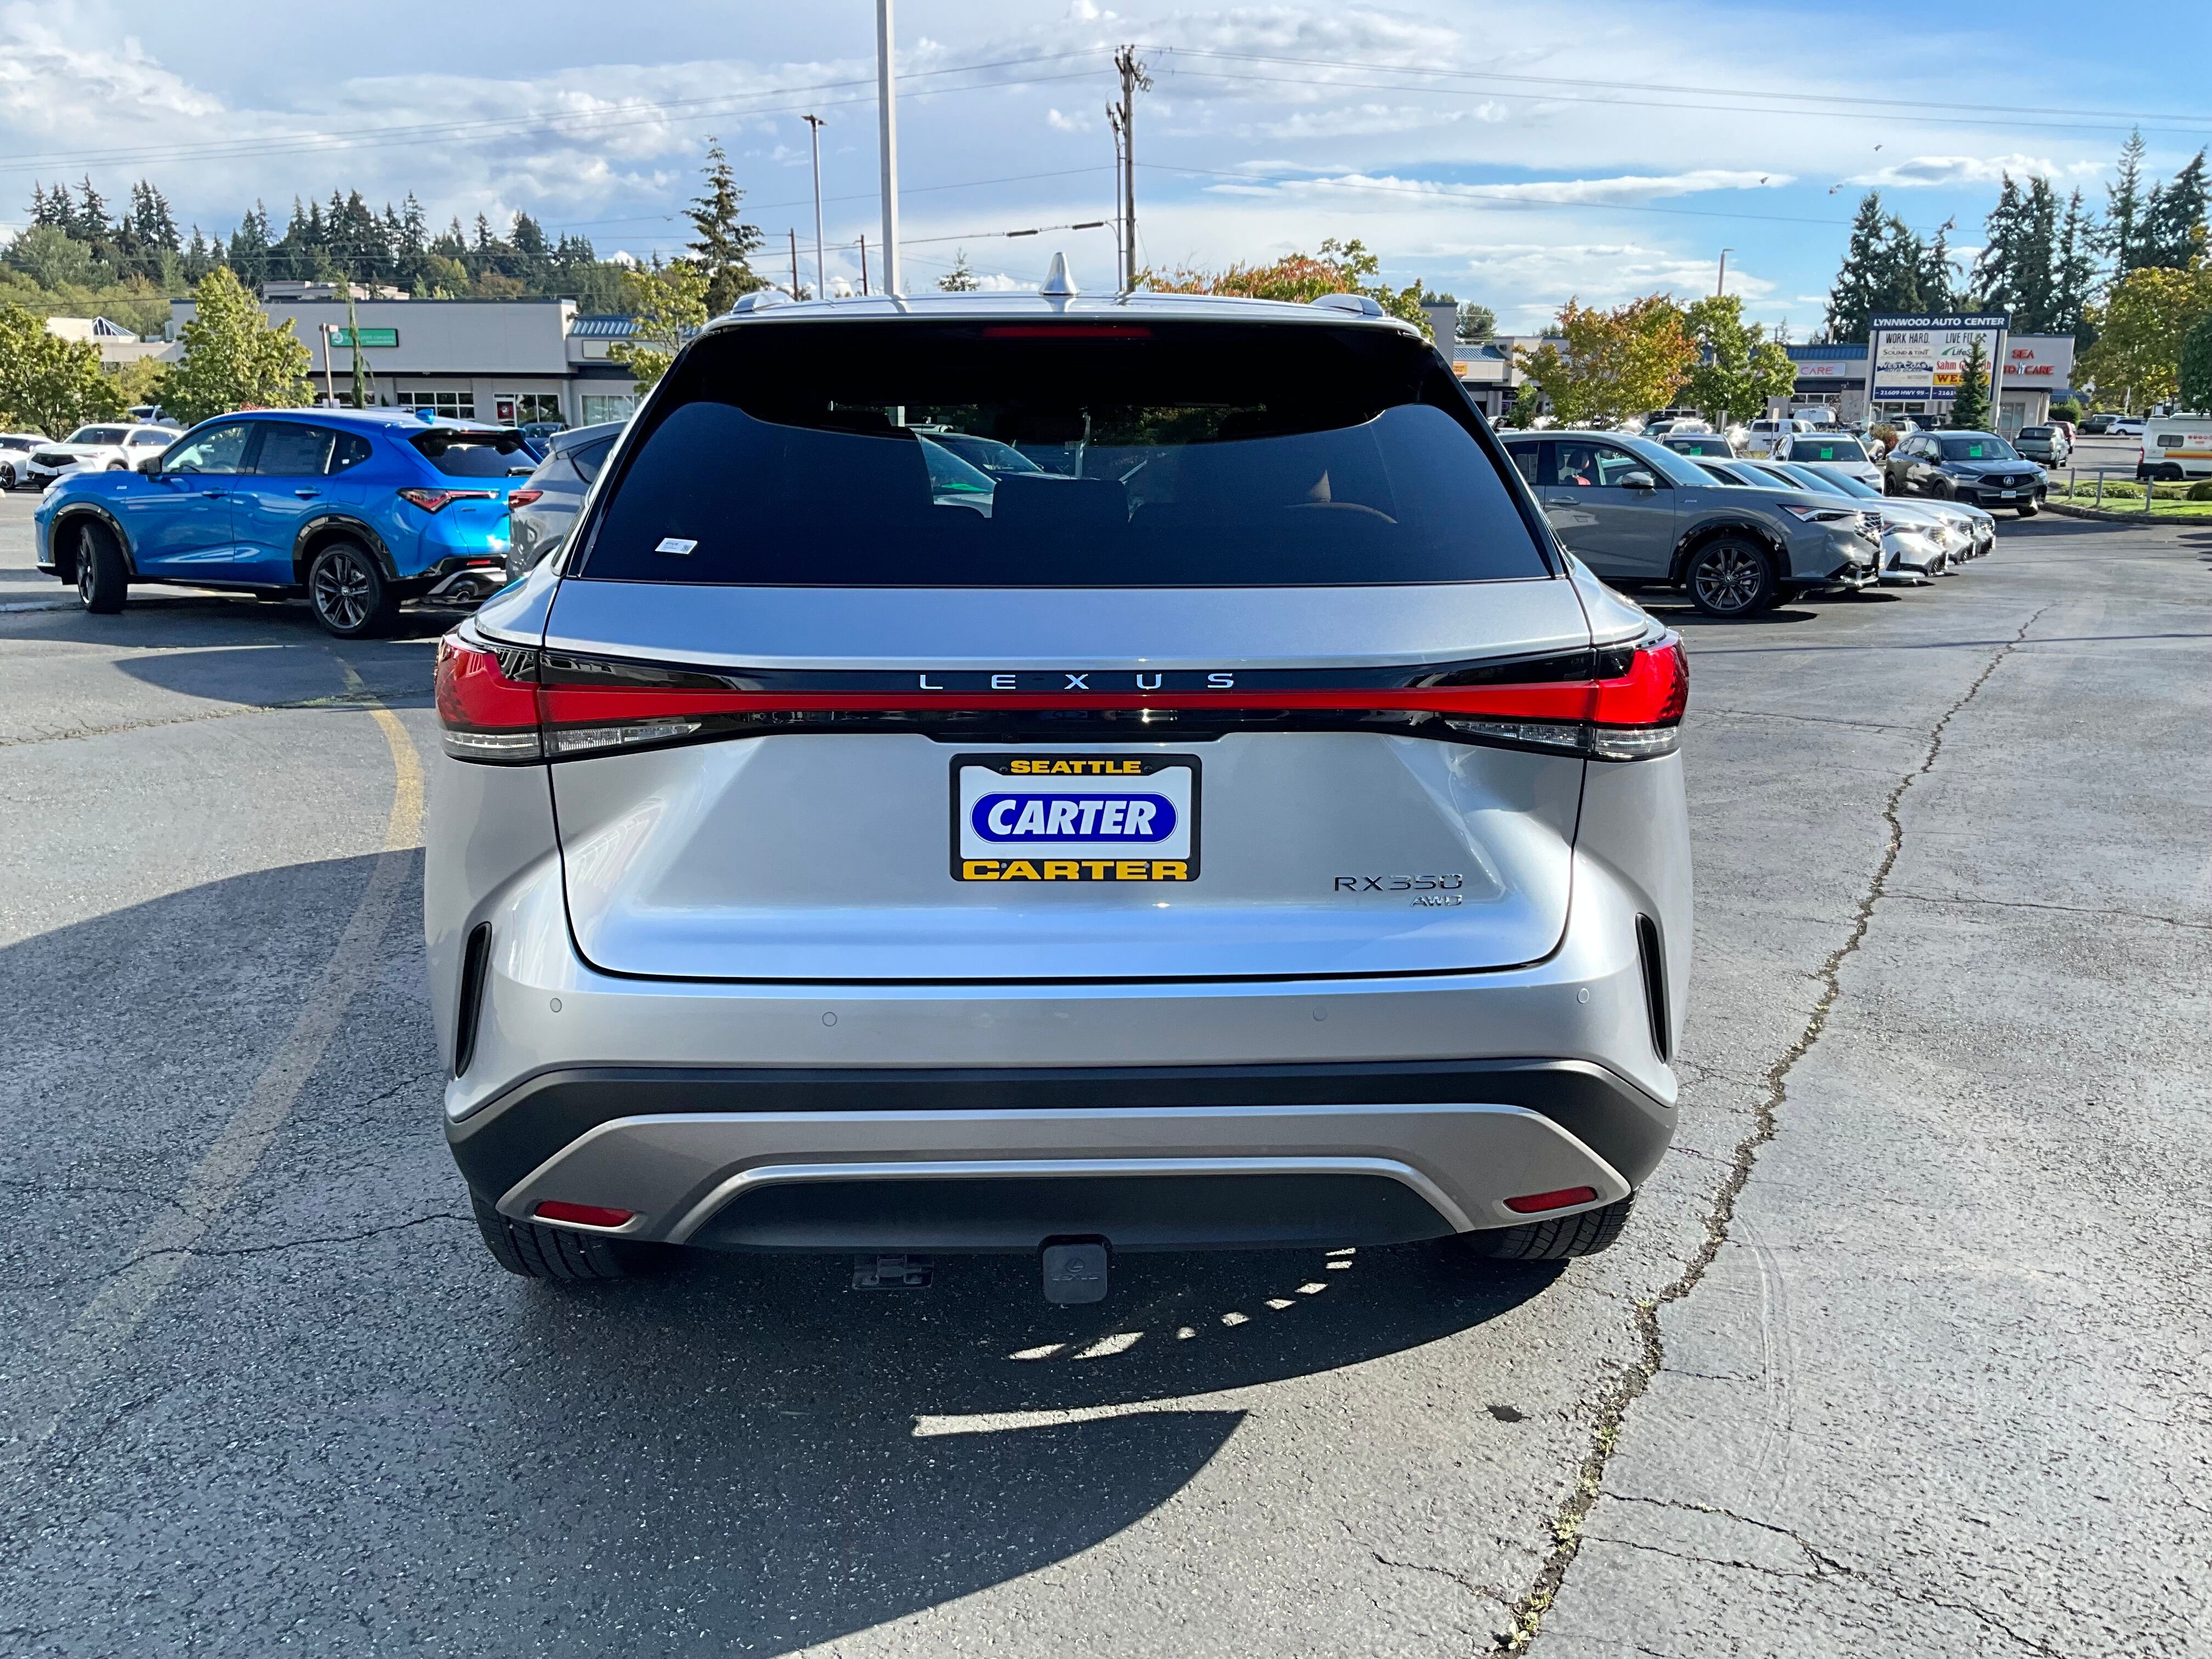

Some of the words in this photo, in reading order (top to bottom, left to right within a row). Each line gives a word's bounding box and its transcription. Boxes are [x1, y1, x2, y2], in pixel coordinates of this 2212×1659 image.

[1874, 318, 1931, 326] LYNNWOOD
[1931, 318, 1961, 326] AUTO
[1964, 317, 2005, 325] CENTER
[1886, 332, 1906, 343] WORK
[1945, 332, 1961, 343] LIVE
[1963, 332, 1973, 343] FIT
[2012, 348, 2034, 359] SEA
[1801, 366, 1835, 375] CARE
[1937, 360, 1956, 370] Sahm
[2004, 364, 2016, 374] TO
[2025, 365, 2055, 375] CARE
[919, 672, 1235, 690] LEXUS
[1011, 760, 1142, 774] SEATTLE
[988, 799, 1156, 836] CARTER
[962, 861, 1188, 881] CARTER
[1409, 894, 1463, 907] AWD
